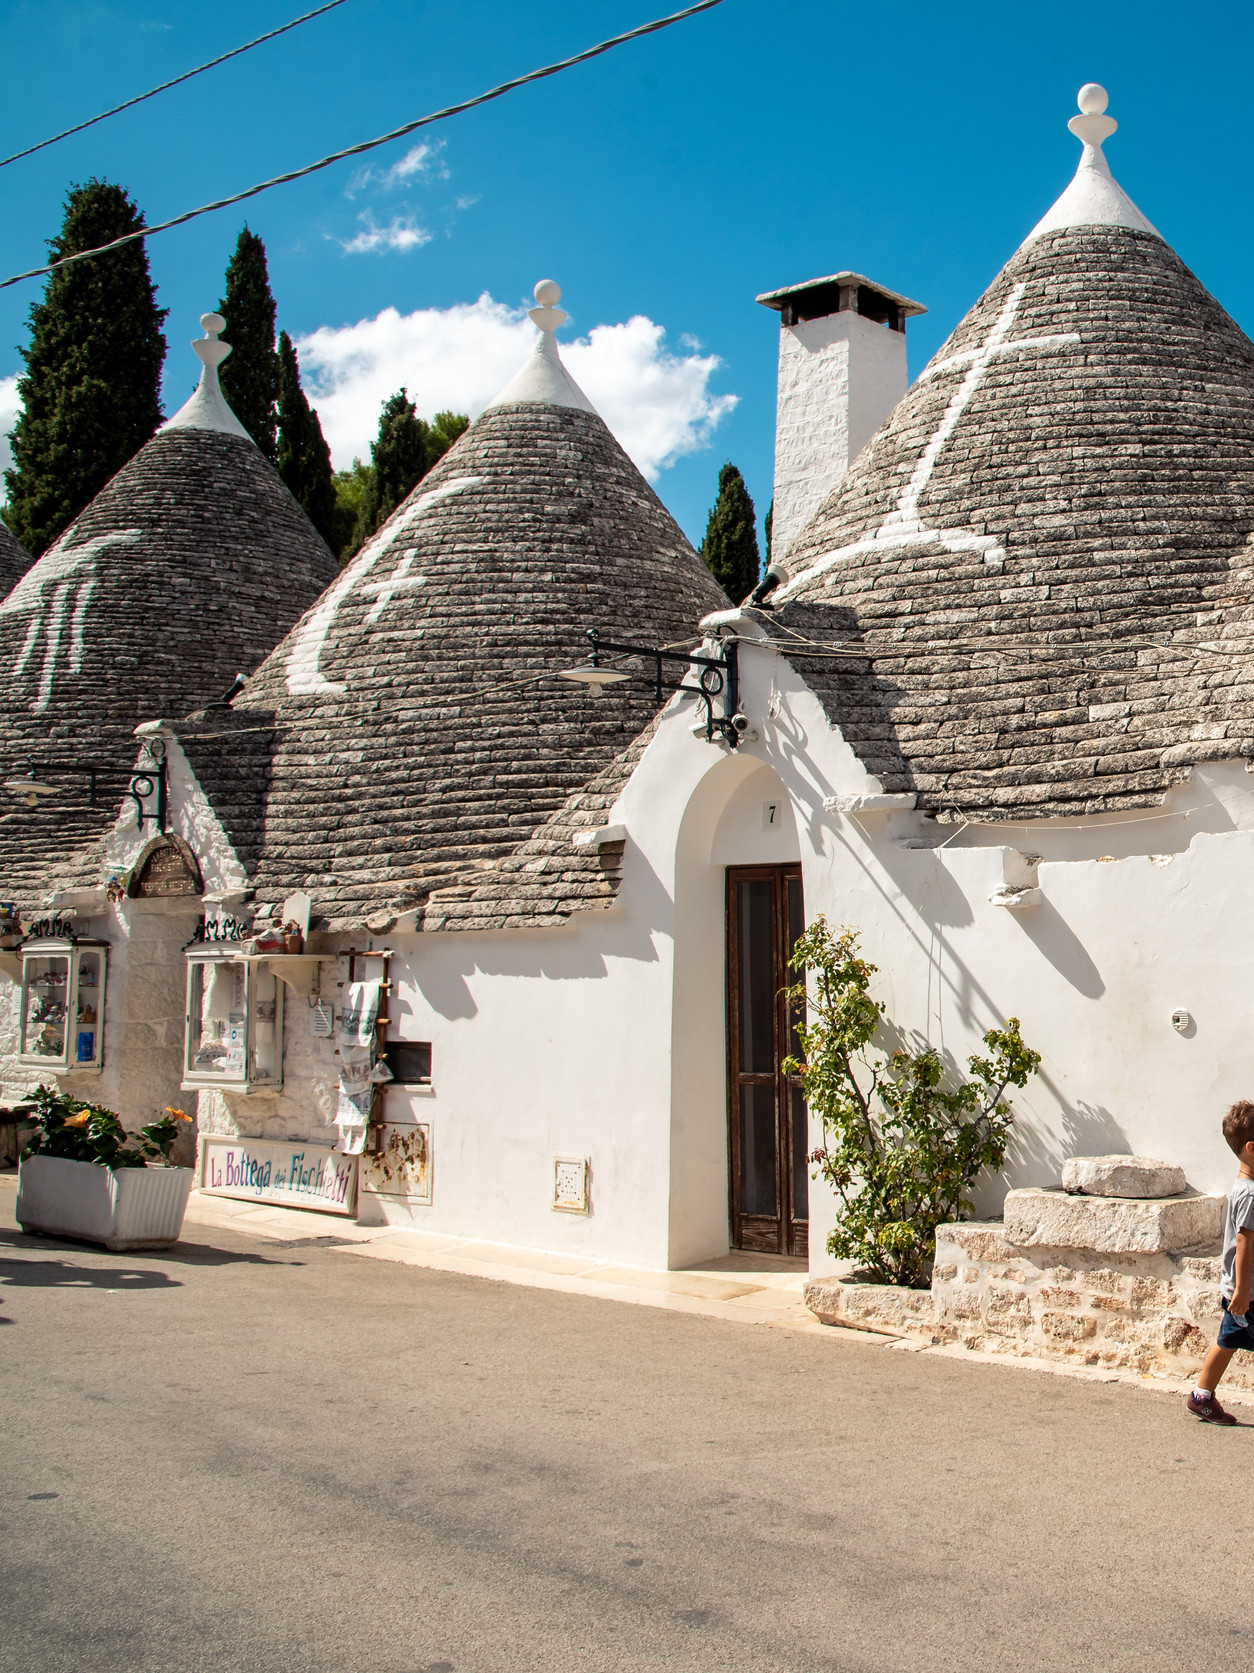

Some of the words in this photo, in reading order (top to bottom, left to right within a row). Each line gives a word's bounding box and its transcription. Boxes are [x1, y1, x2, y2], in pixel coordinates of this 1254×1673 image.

[769, 806, 776, 823] 7
[211, 1157, 222, 1188] La
[226, 1151, 272, 1195] Bottega
[275, 1168, 286, 1190] dei
[289, 1152, 352, 1204] Fischietti
